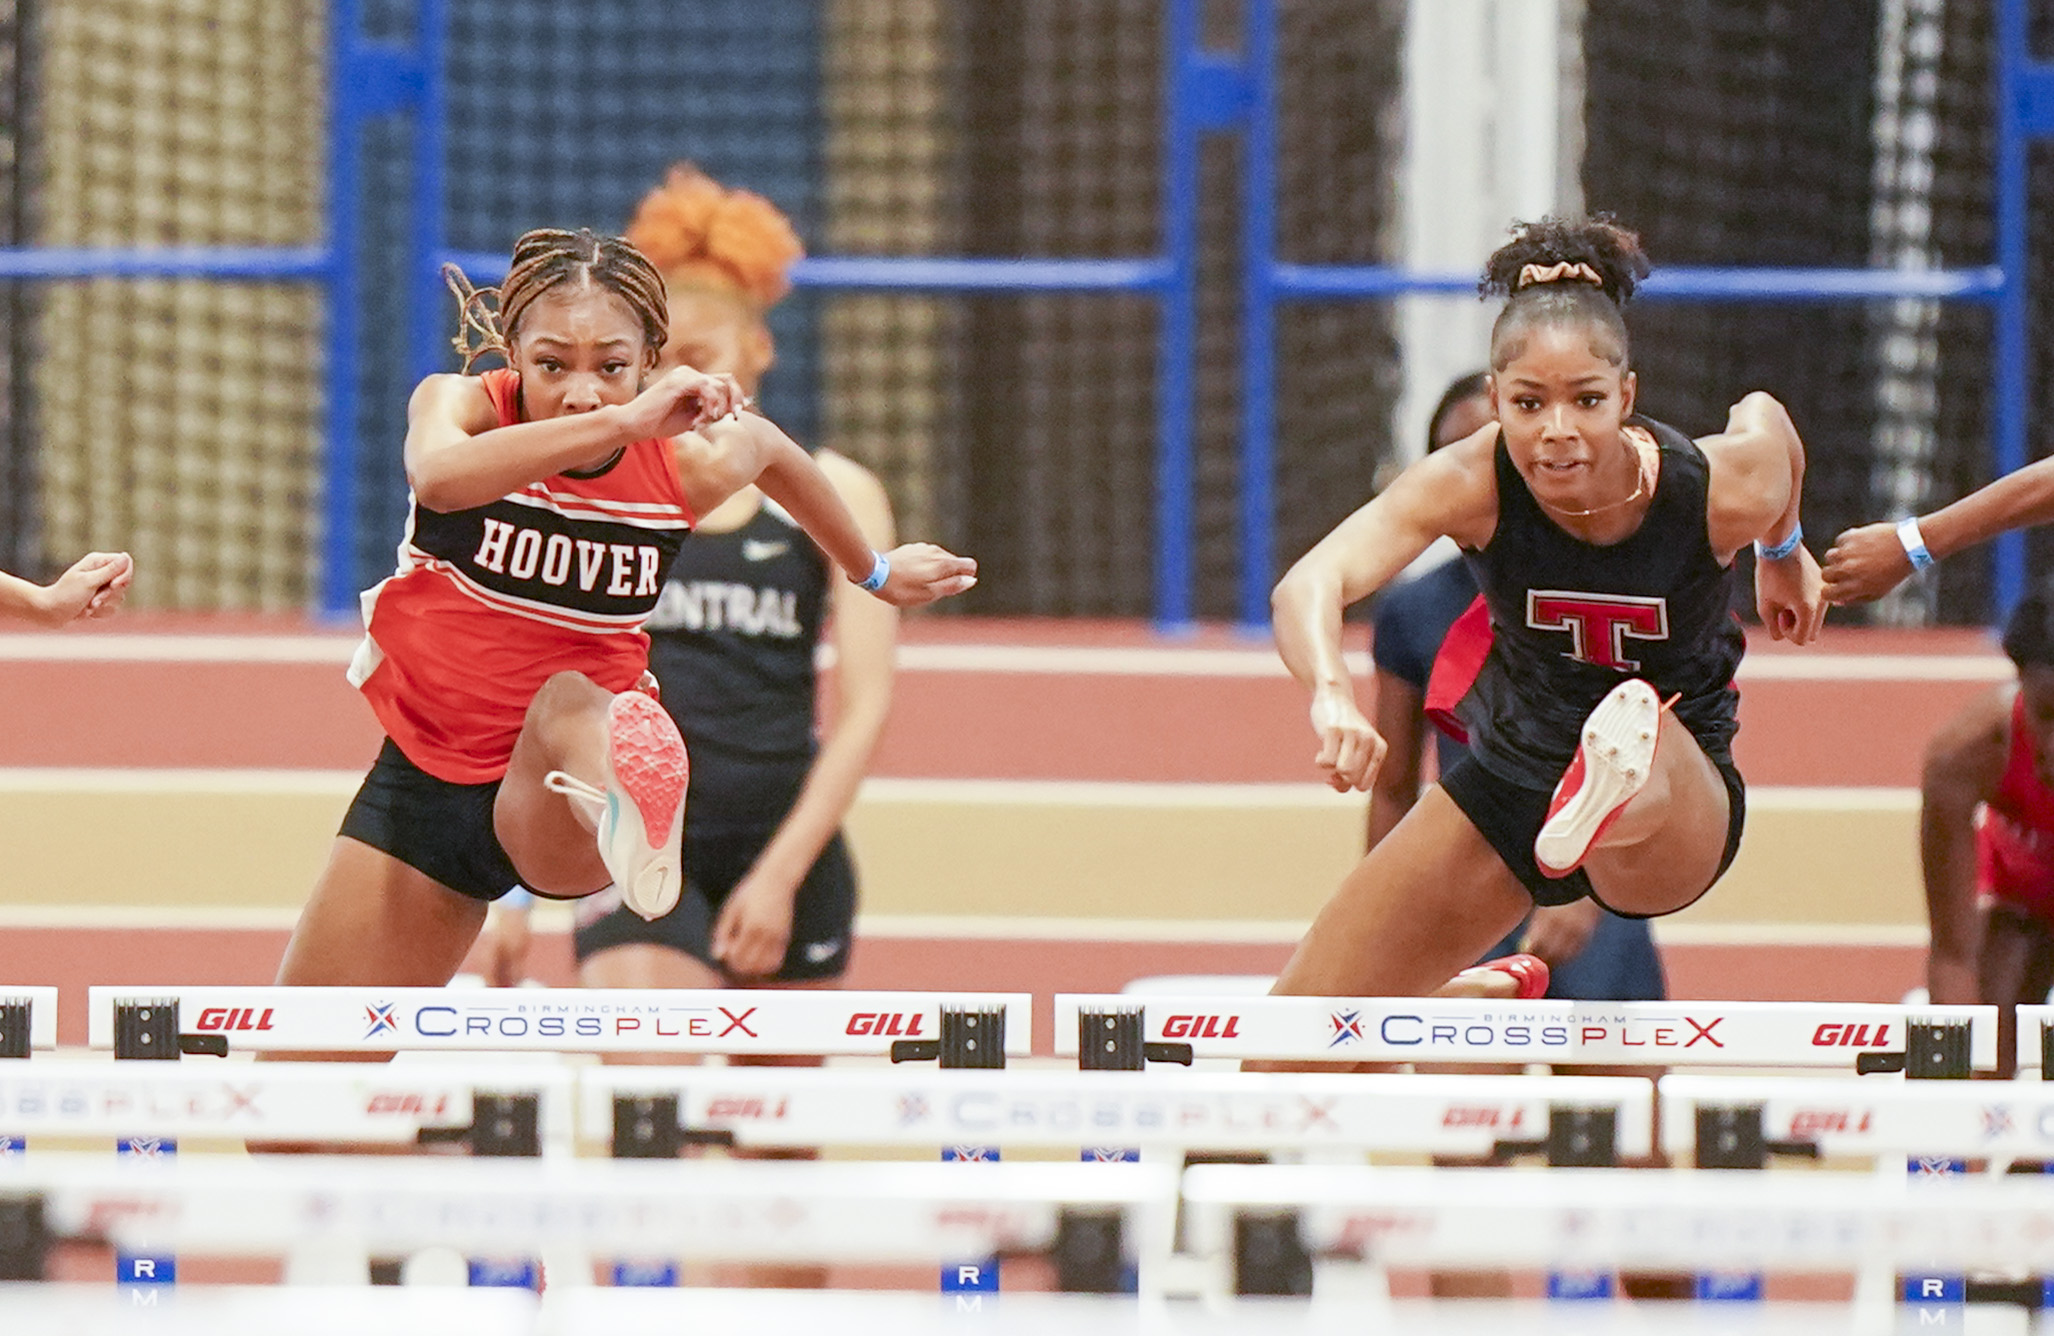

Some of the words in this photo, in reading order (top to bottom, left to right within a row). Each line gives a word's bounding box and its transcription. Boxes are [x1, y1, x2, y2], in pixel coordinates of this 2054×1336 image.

[473, 517, 661, 597] HOOVER
[1526, 588, 1670, 673] T
[196, 1007, 275, 1032] GILL
[517, 1004, 661, 1014] BIRMINGHAM
[1483, 1013, 1628, 1024] BIRMINGHAM
[844, 1012, 924, 1036] GILL
[1161, 1015, 1240, 1039] GILL
[1811, 1023, 1890, 1047] GILL
